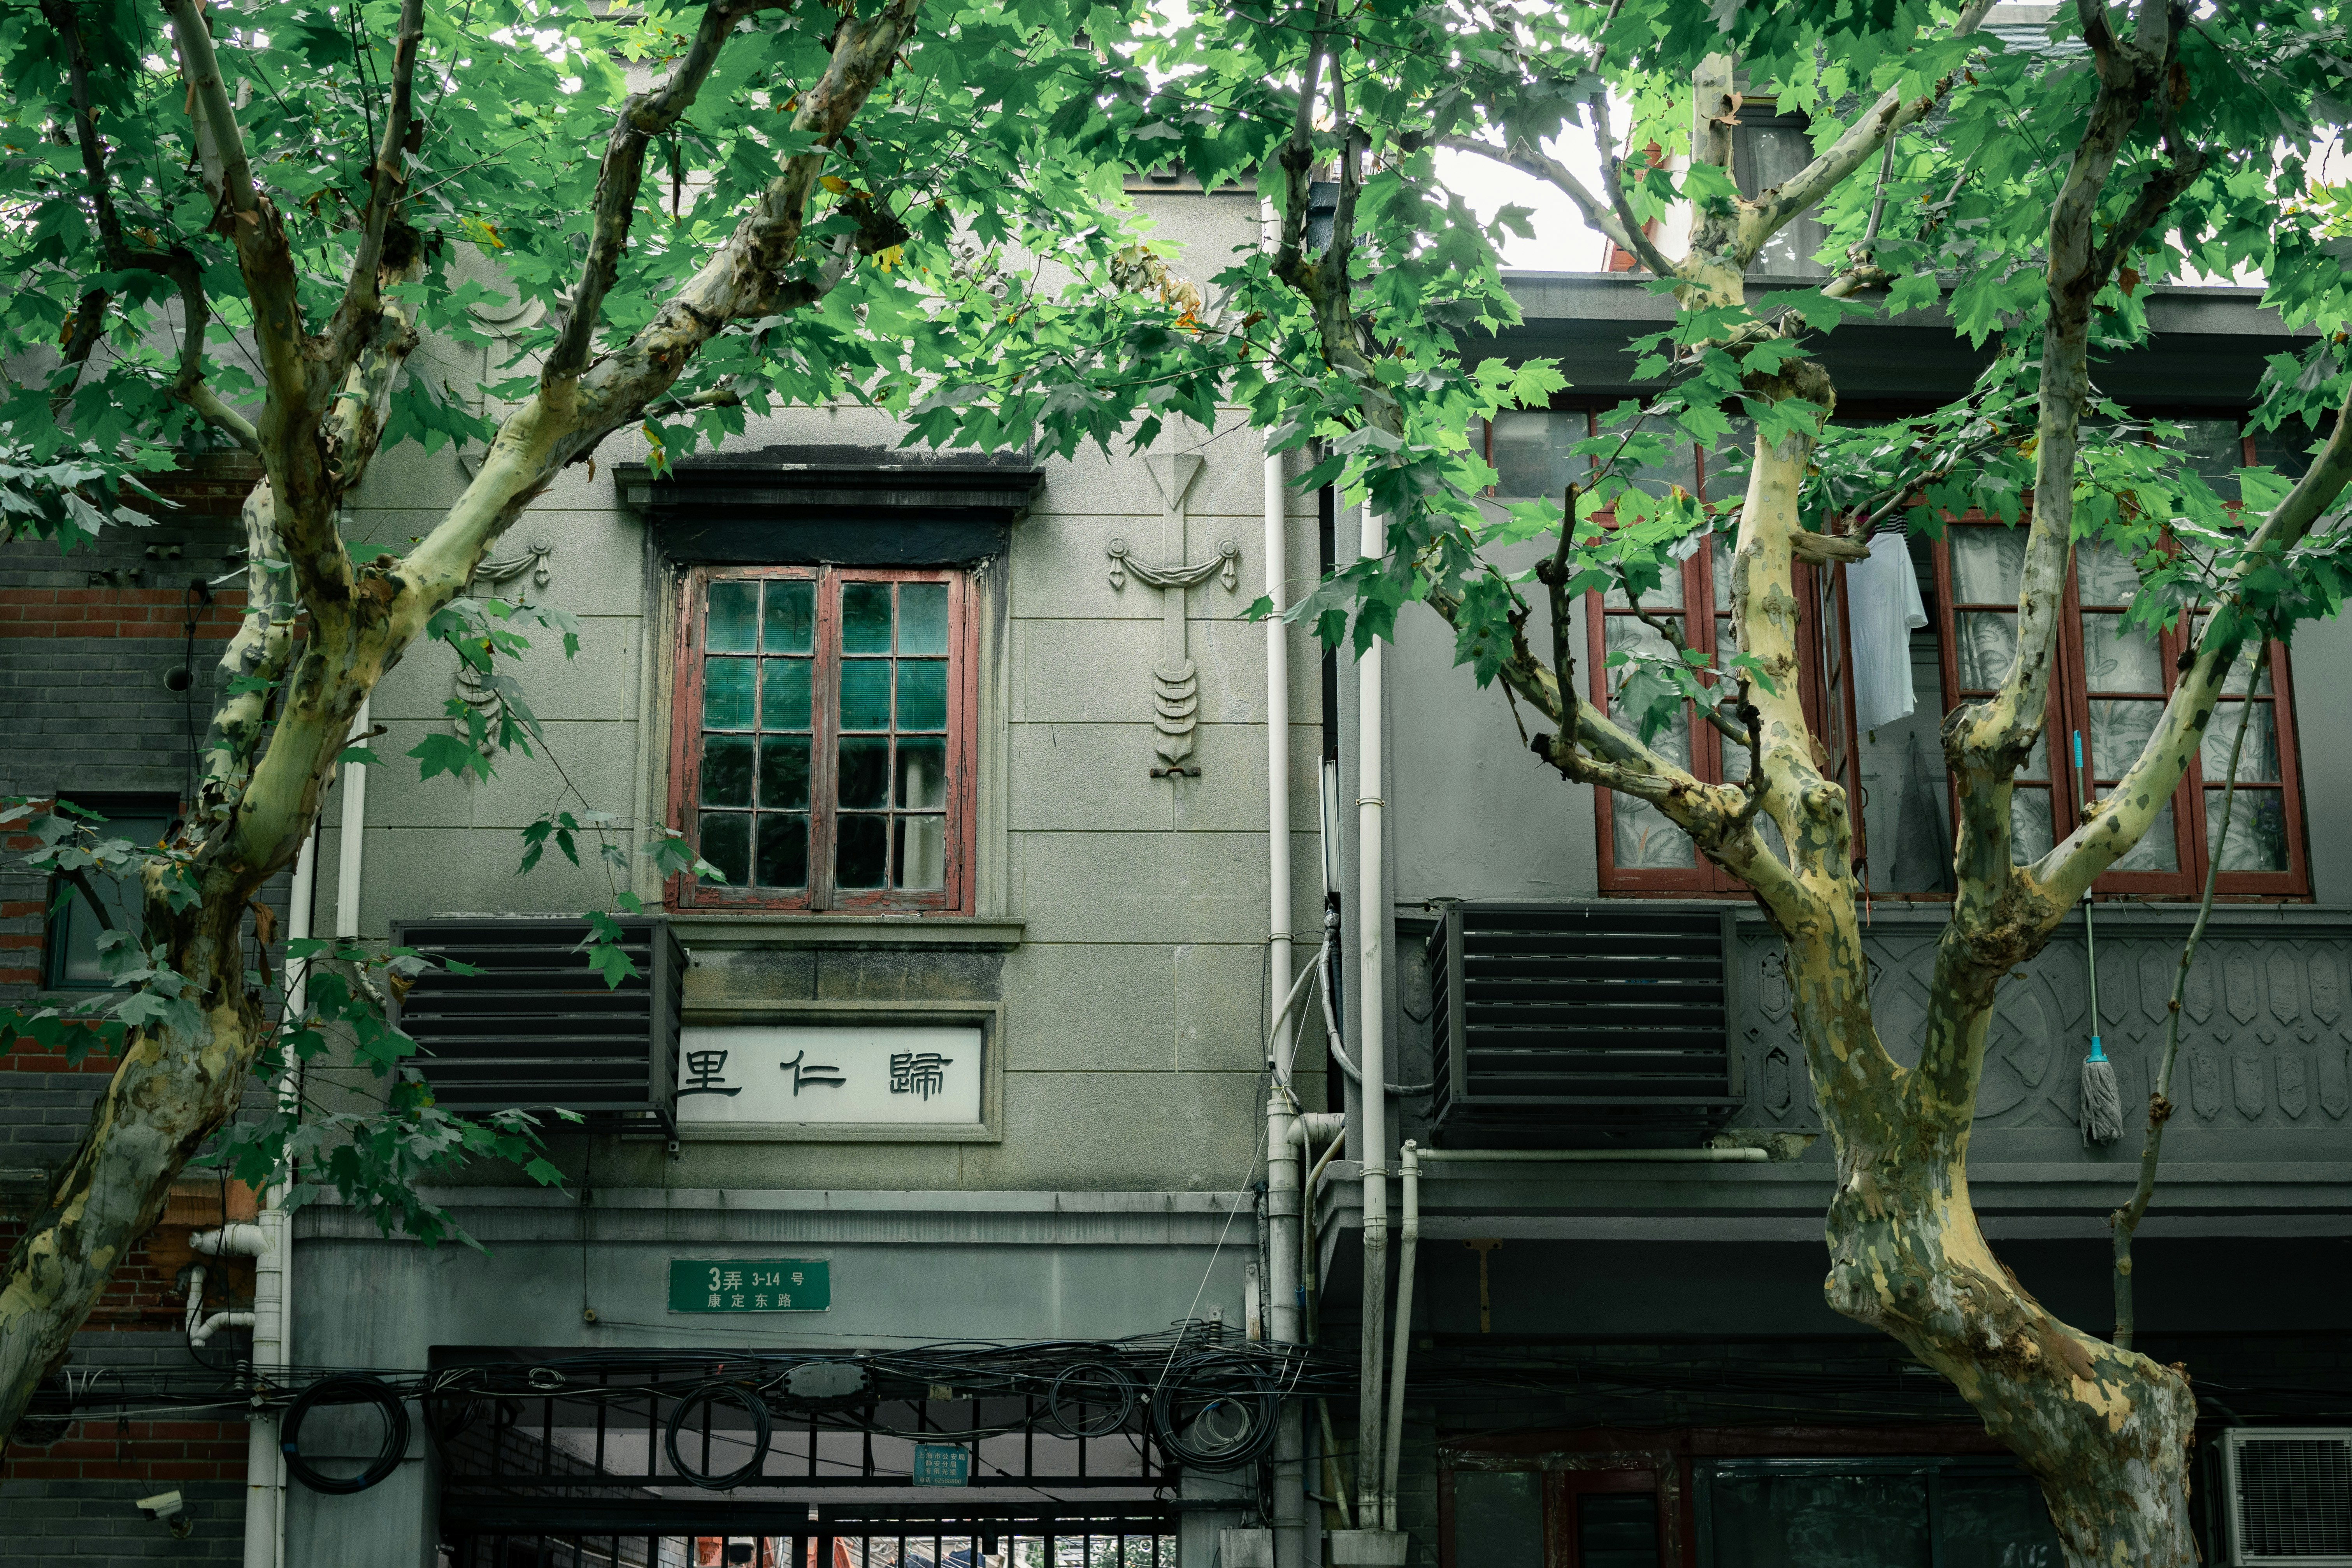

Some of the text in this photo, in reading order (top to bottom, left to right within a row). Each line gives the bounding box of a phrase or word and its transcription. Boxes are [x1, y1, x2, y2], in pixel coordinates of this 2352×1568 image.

[708, 1267, 804, 1291] 3弄 3-14 号
[708, 1293, 791, 1307] 康定东路
[918, 1452, 965, 1461] 上海市公安局
